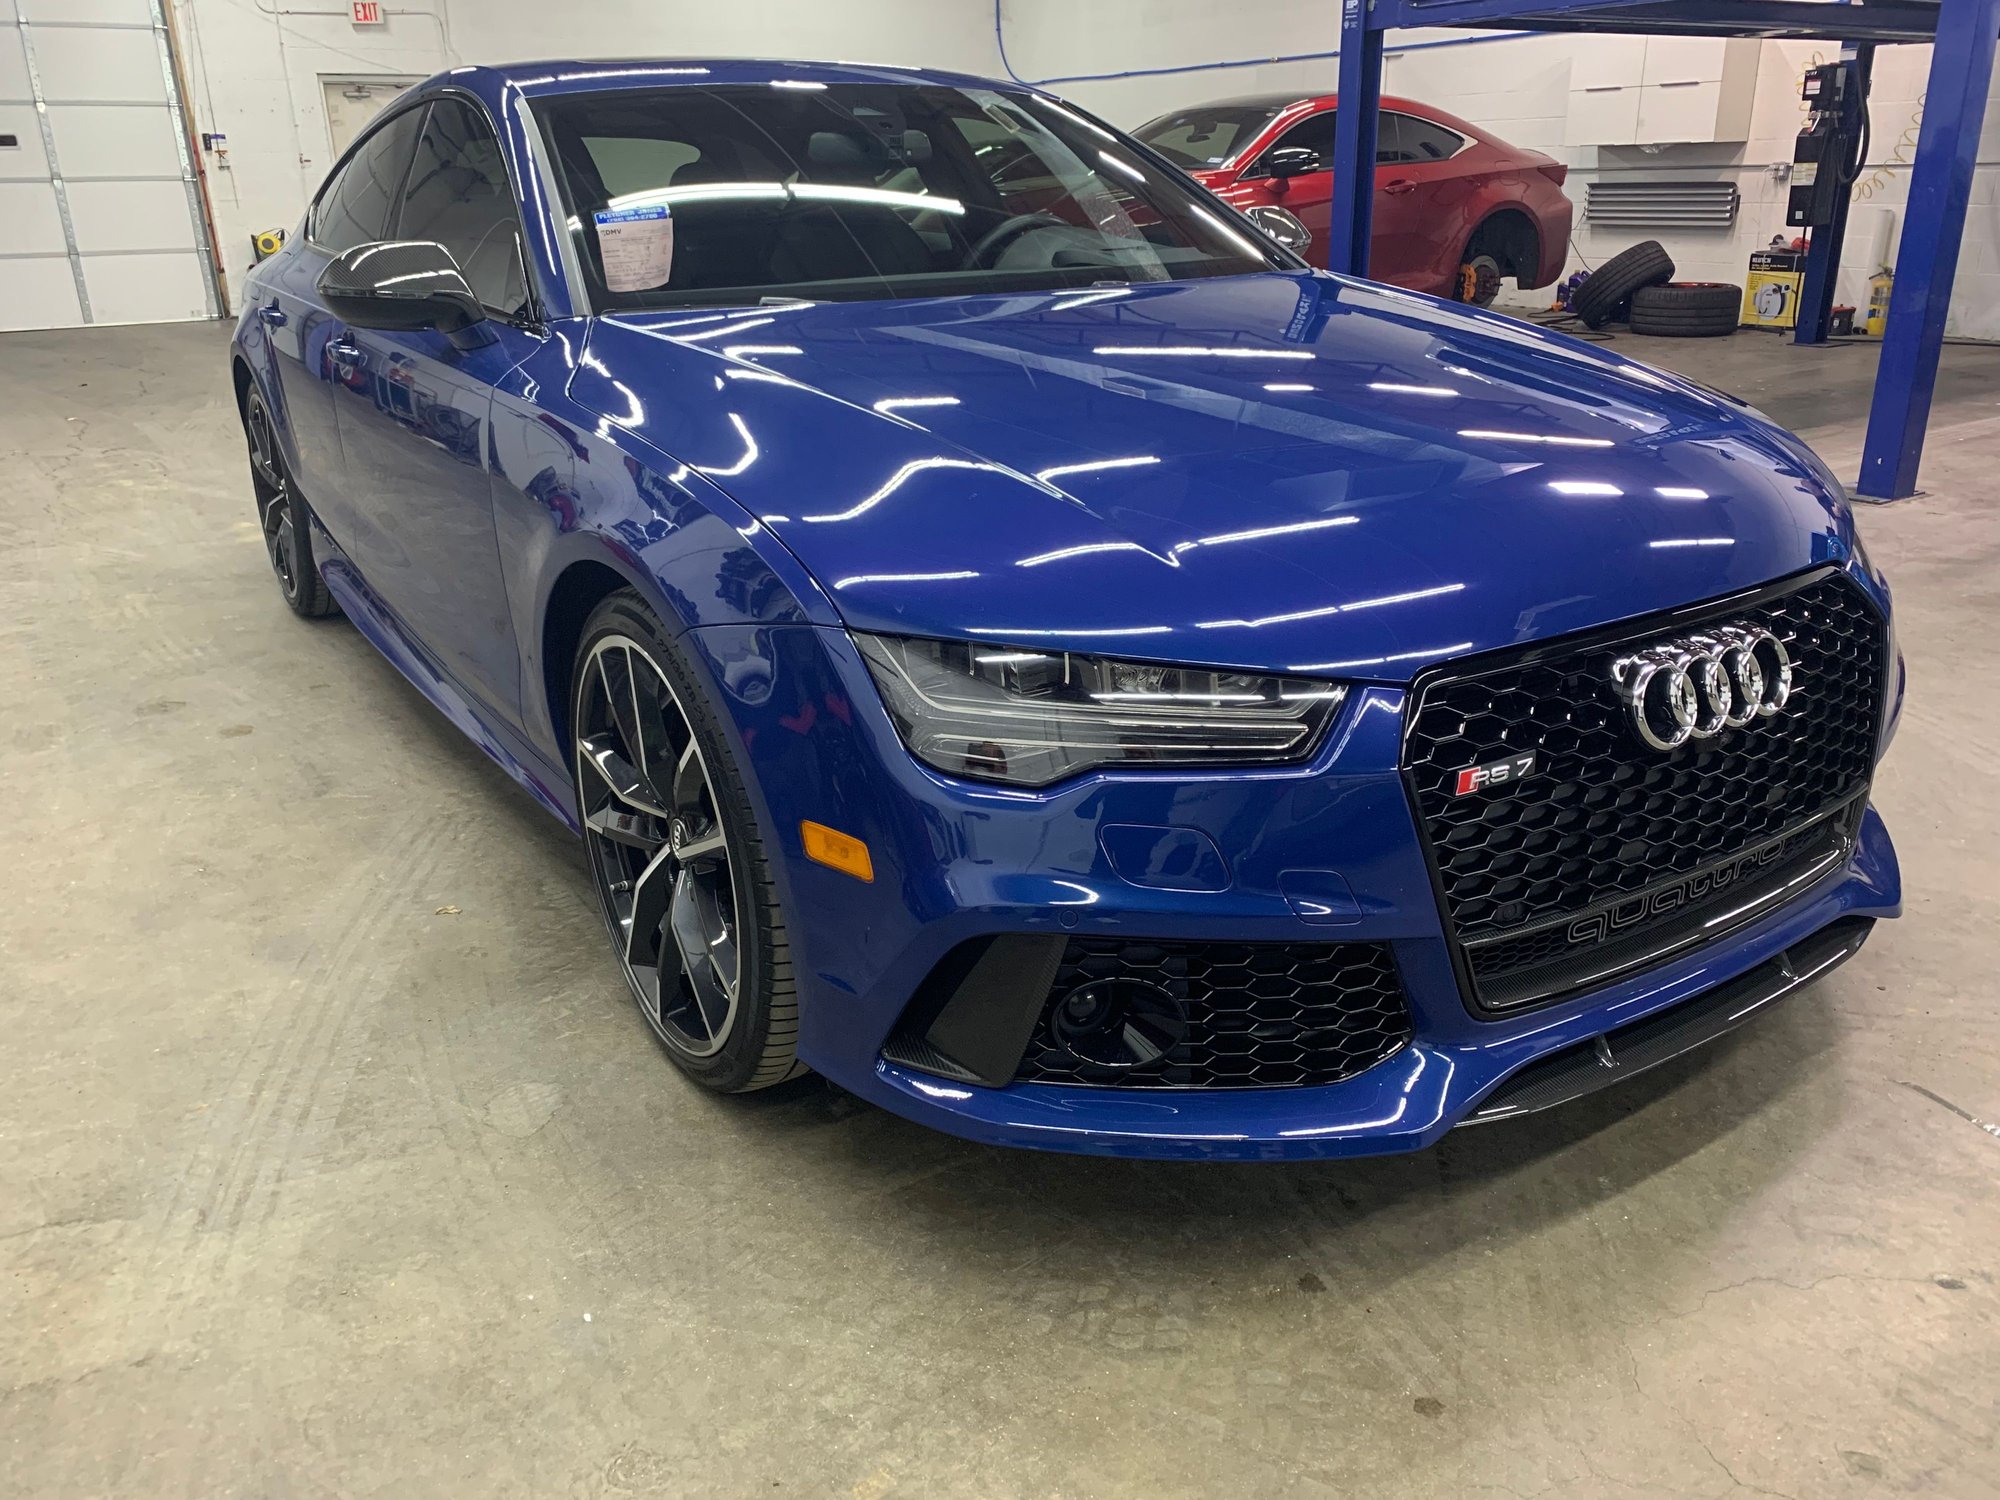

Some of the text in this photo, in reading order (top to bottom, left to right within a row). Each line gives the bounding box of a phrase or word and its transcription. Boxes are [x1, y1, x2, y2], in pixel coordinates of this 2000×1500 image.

[353, 2, 378, 21] EXIT
[1469, 757, 1533, 790] RS 7
[1567, 839, 1785, 943] quattro
